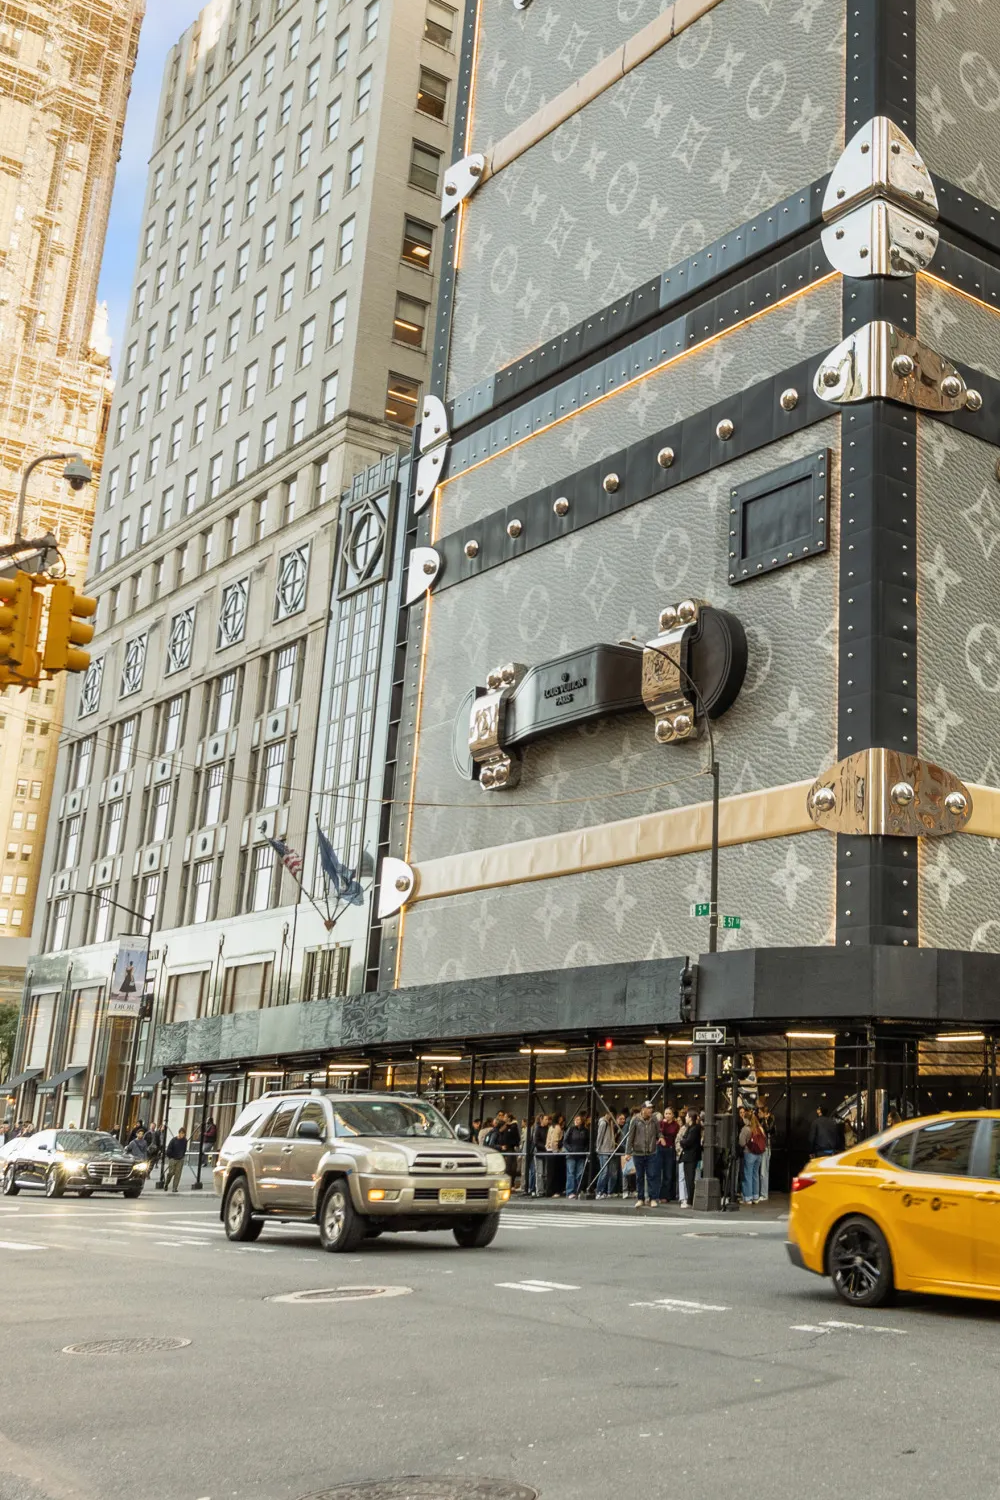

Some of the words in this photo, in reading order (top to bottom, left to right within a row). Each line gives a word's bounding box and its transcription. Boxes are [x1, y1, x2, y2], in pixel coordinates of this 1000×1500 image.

[728, 917, 735, 927] 57
[114, 1003, 134, 1011] DIOR
[698, 1032, 707, 1040] ONE
